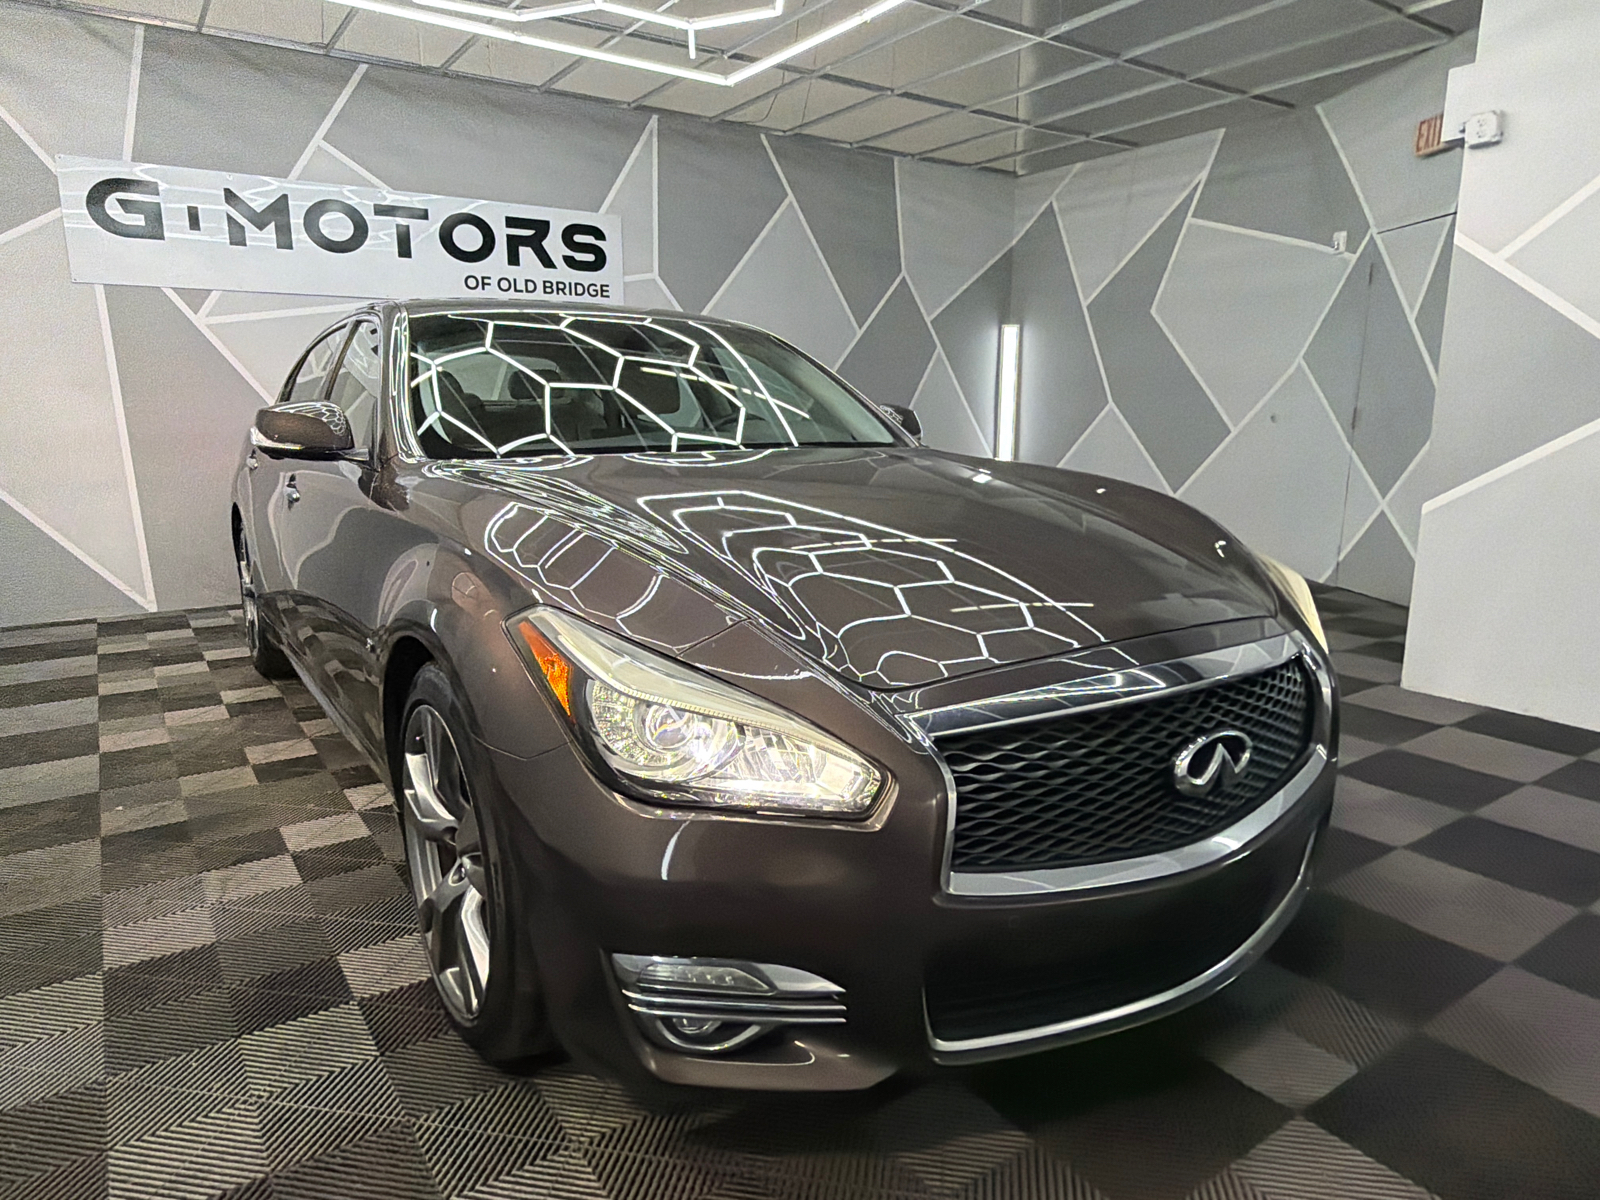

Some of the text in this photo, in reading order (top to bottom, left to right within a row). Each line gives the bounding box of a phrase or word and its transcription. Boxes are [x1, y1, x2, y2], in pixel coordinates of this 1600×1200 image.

[464, 274, 610, 298] OF OLD BRIDGE
